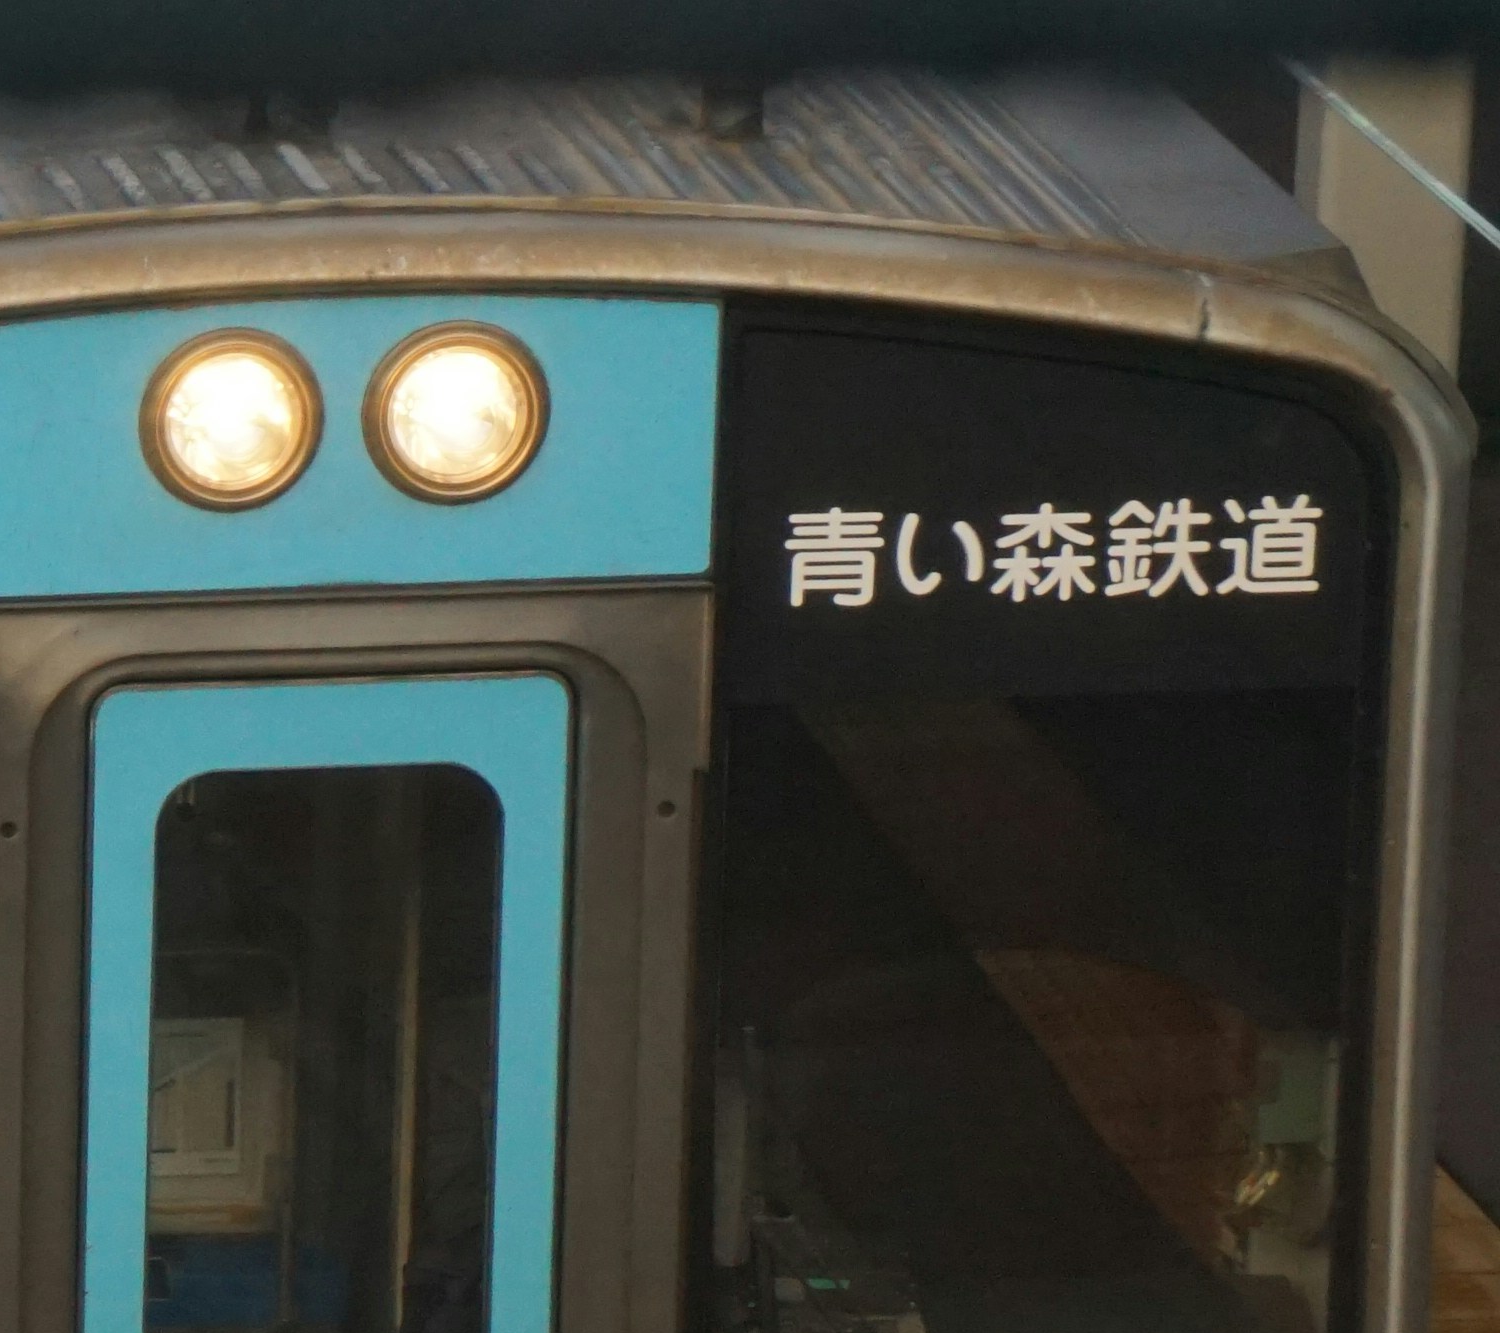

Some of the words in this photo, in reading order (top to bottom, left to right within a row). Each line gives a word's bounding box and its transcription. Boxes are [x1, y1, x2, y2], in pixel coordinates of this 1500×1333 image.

[784, 494, 1324, 606] 青い森鉄道
